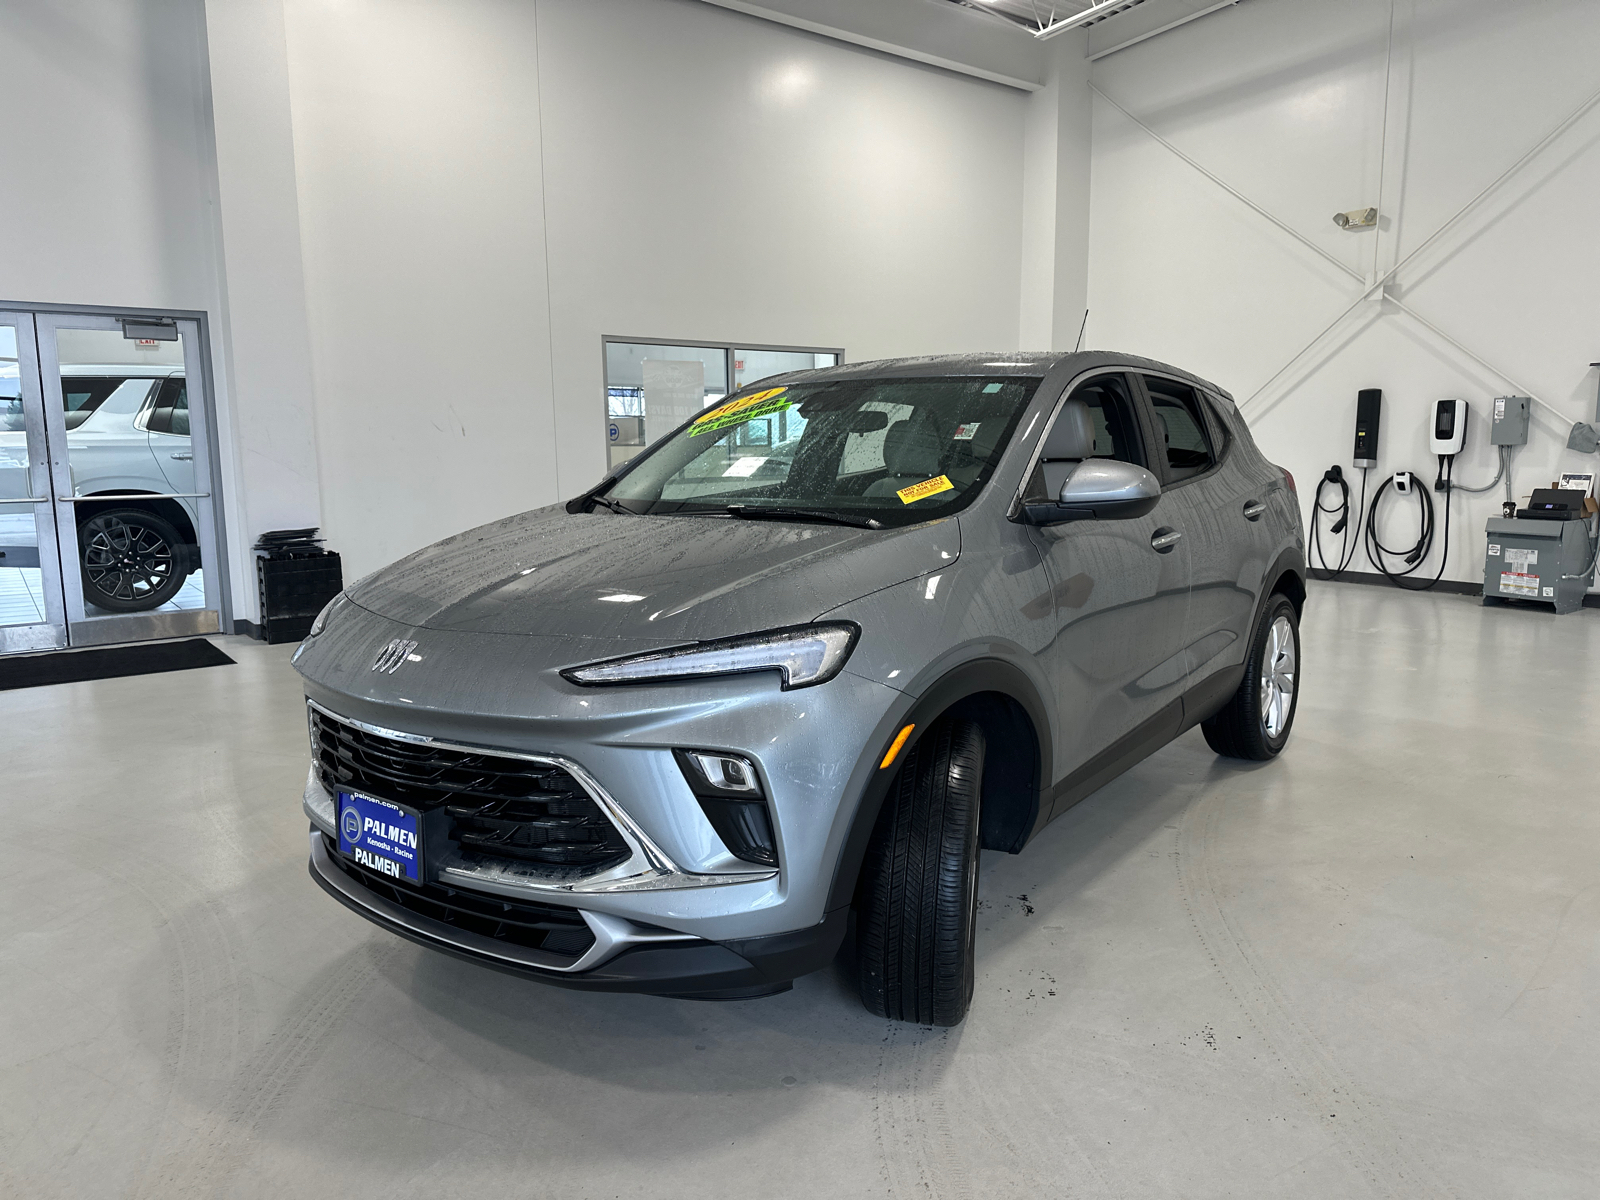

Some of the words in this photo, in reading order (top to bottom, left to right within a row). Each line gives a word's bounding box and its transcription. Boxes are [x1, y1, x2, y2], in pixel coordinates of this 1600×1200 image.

[693, 424, 715, 436] ALL
[716, 413, 753, 428] WHEEL
[753, 404, 785, 418] DRIVE
[704, 389, 774, 421] 2024
[900, 486, 916, 494] THIS
[915, 476, 945, 488] VEHICLE
[353, 791, 399, 811] palmen.com
[363, 816, 418, 850] PALMEN
[366, 836, 391, 852] Kenosha
[394, 846, 414, 860] Racine
[354, 847, 400, 879] PALMEN
